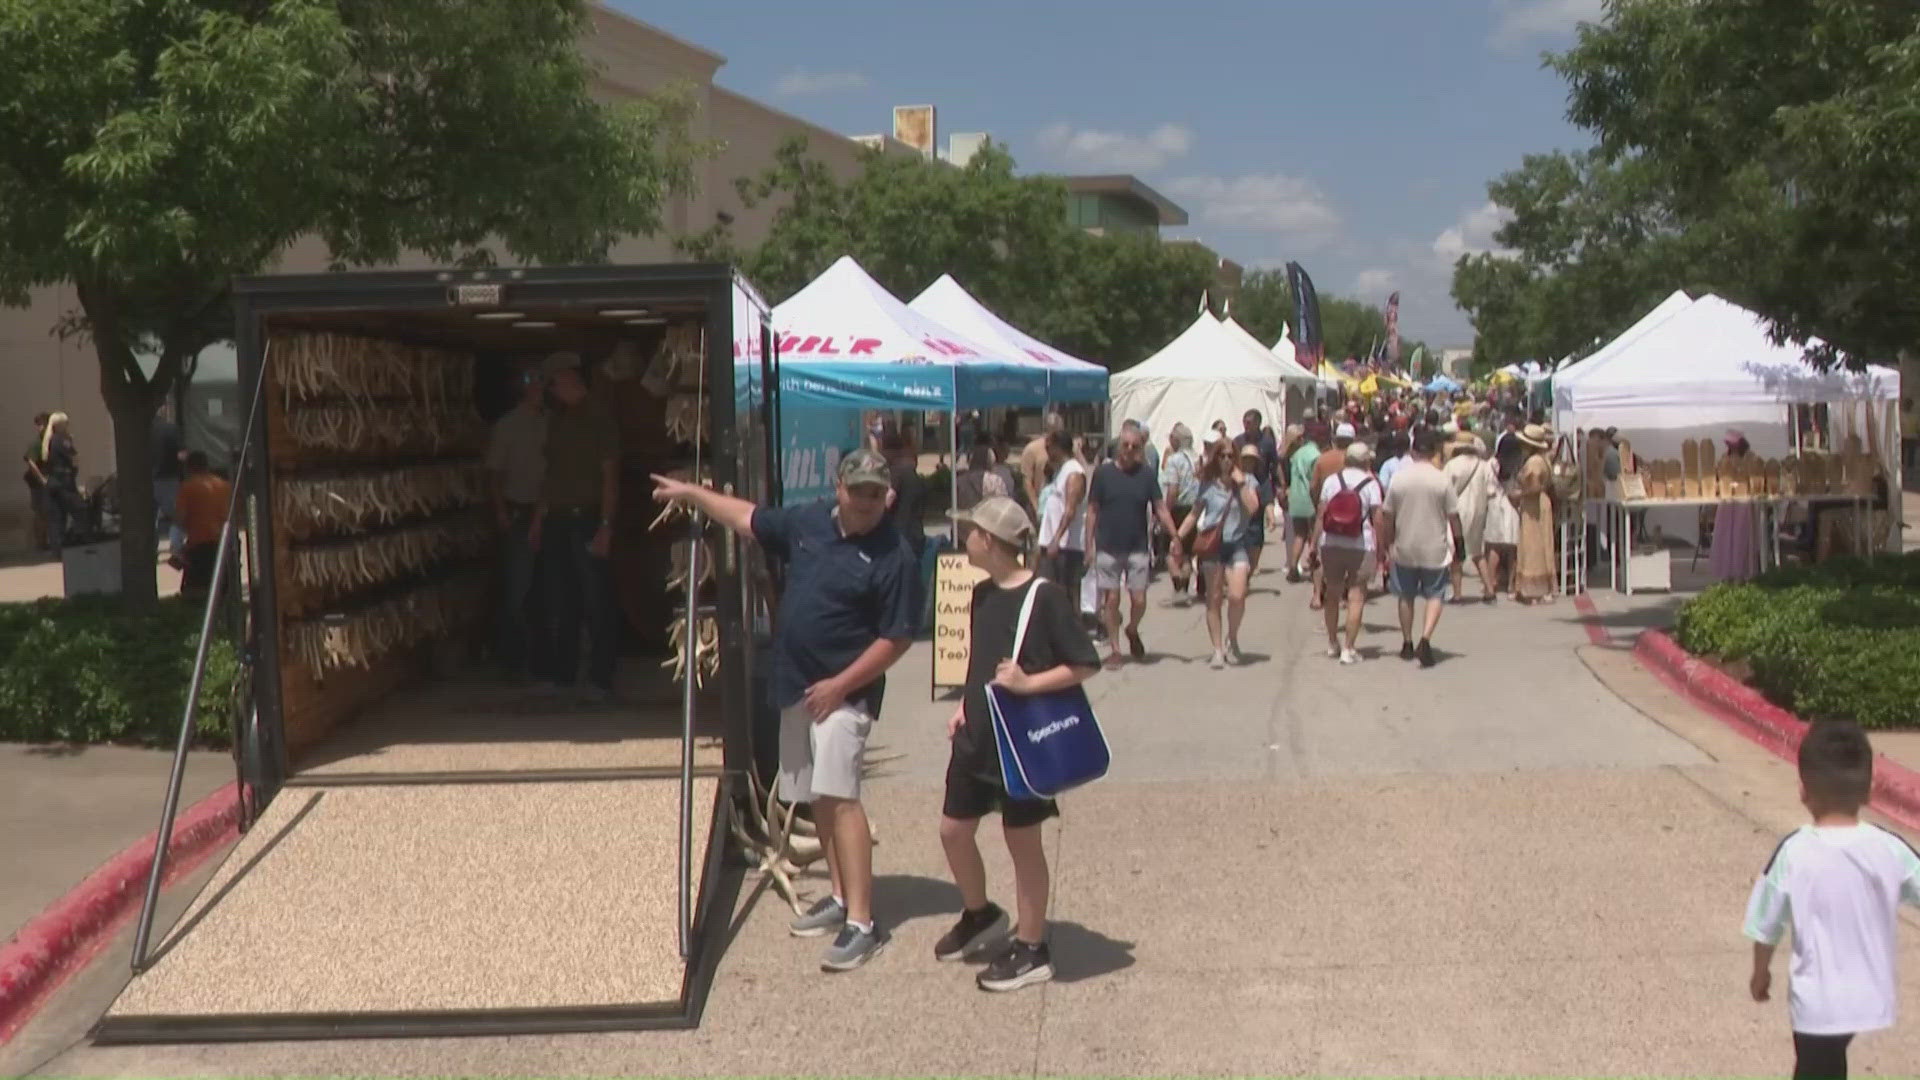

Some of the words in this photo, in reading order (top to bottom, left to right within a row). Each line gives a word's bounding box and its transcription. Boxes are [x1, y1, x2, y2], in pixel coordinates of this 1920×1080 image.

[939, 558, 963, 570] We
[937, 602, 971, 616] (And
[937, 624, 965, 641] Dog
[938, 647, 968, 661] Too)
[1026, 714, 1080, 744] Spectrum
